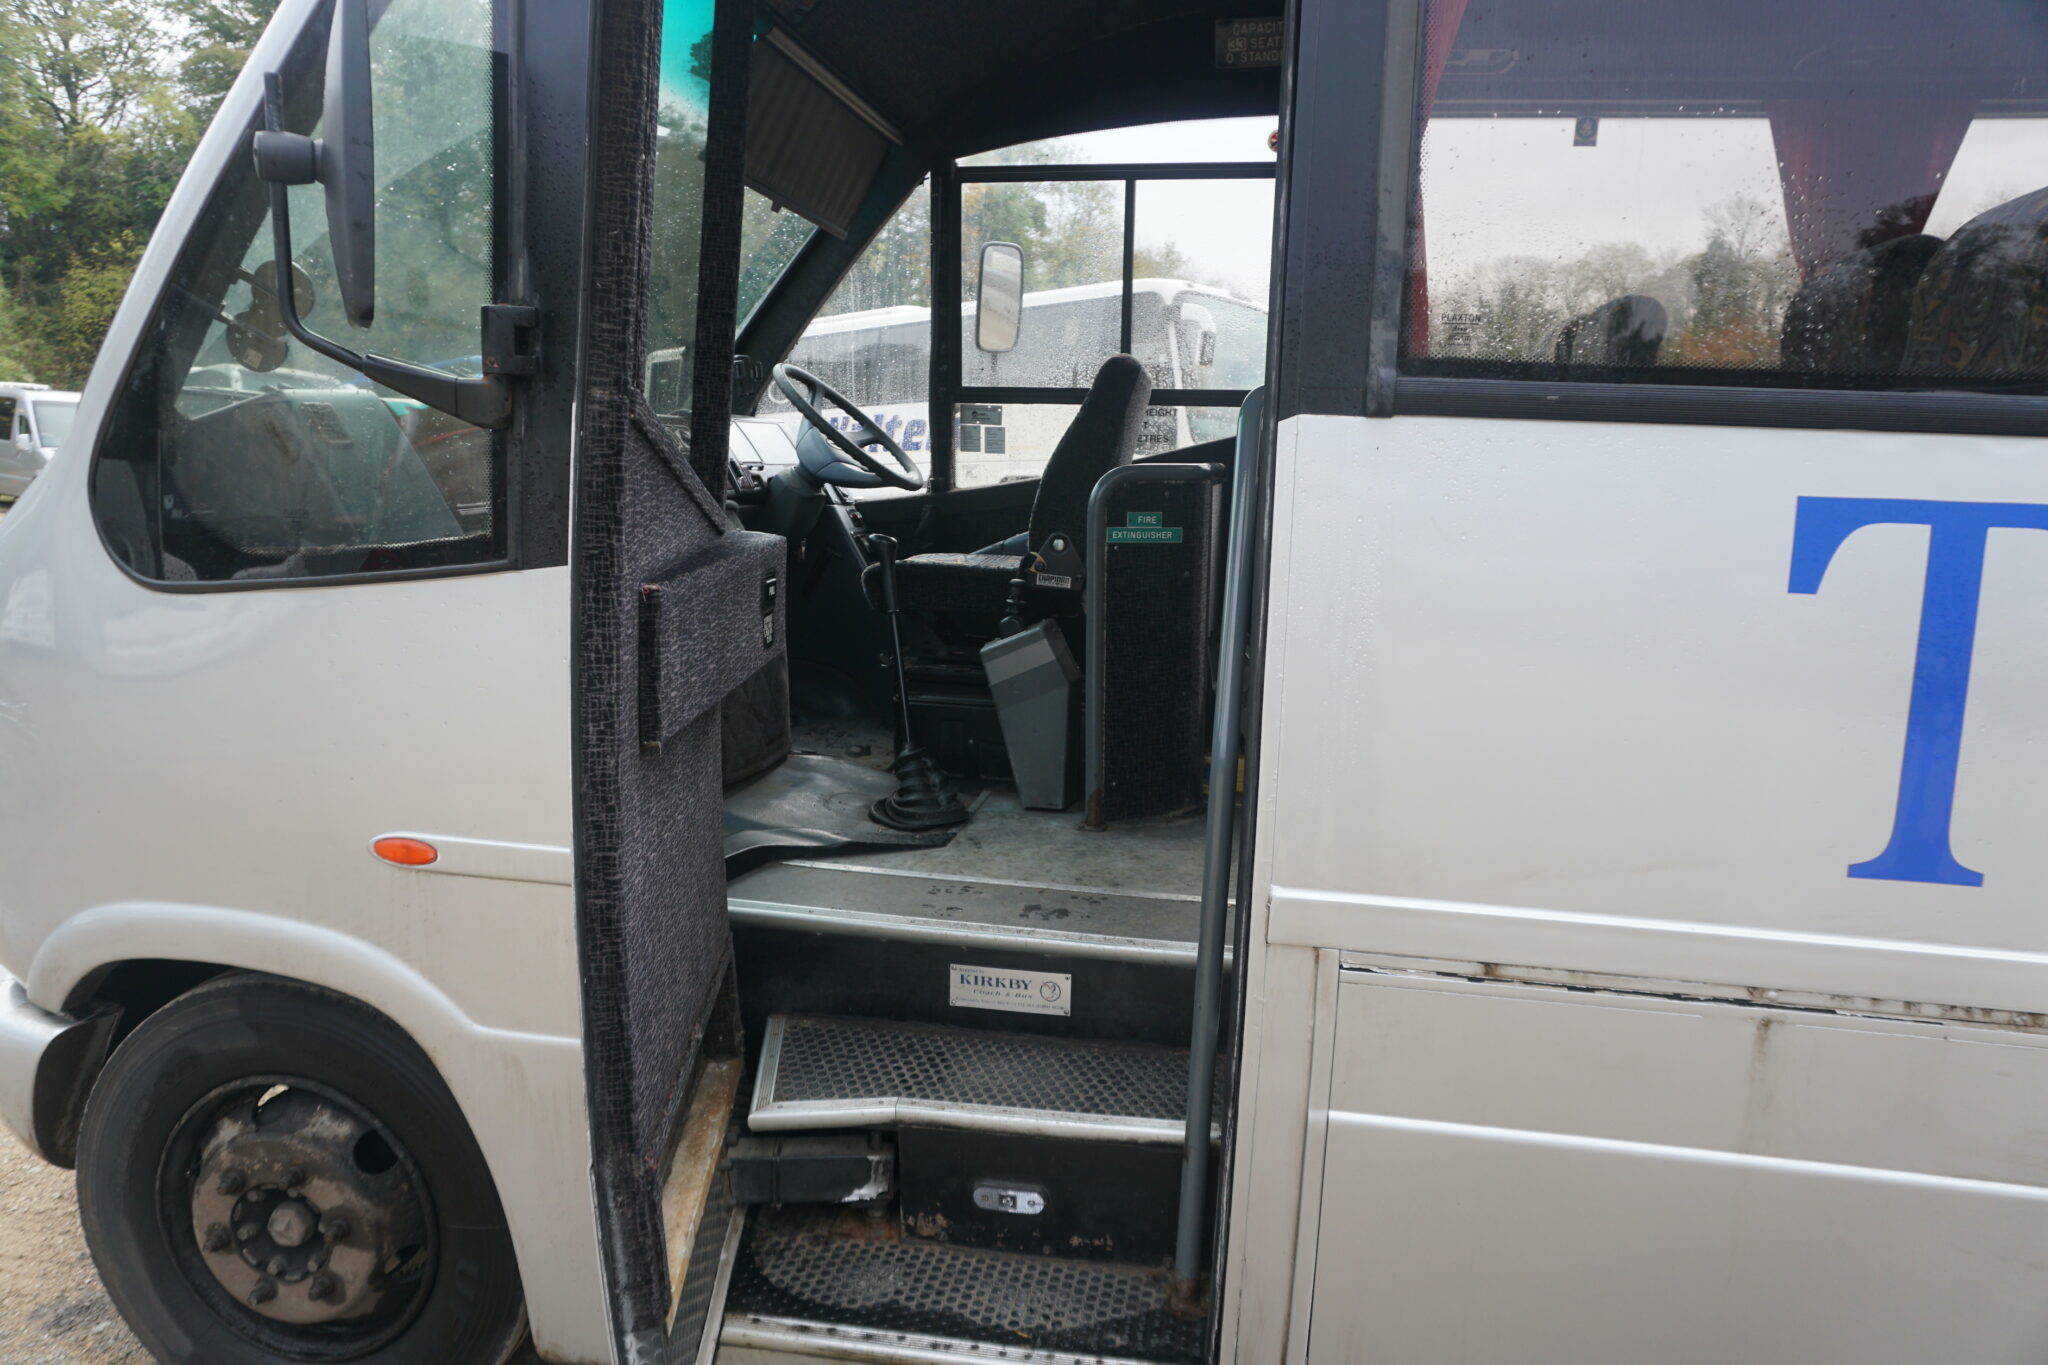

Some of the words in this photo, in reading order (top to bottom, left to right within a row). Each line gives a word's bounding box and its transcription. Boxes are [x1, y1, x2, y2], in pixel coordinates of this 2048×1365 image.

[1232, 21, 1284, 35] CAPACIT
[1250, 36, 1281, 48] SEAT
[1239, 50, 1282, 63] STAND
[1441, 313, 1482, 322] PLAXTON
[1137, 434, 1169, 443] ETRES
[1137, 516, 1157, 524] FIRE
[1112, 531, 1172, 539] EXTINGUISHER
[1787, 496, 2048, 888] T
[960, 974, 1032, 990] KIRKBY
